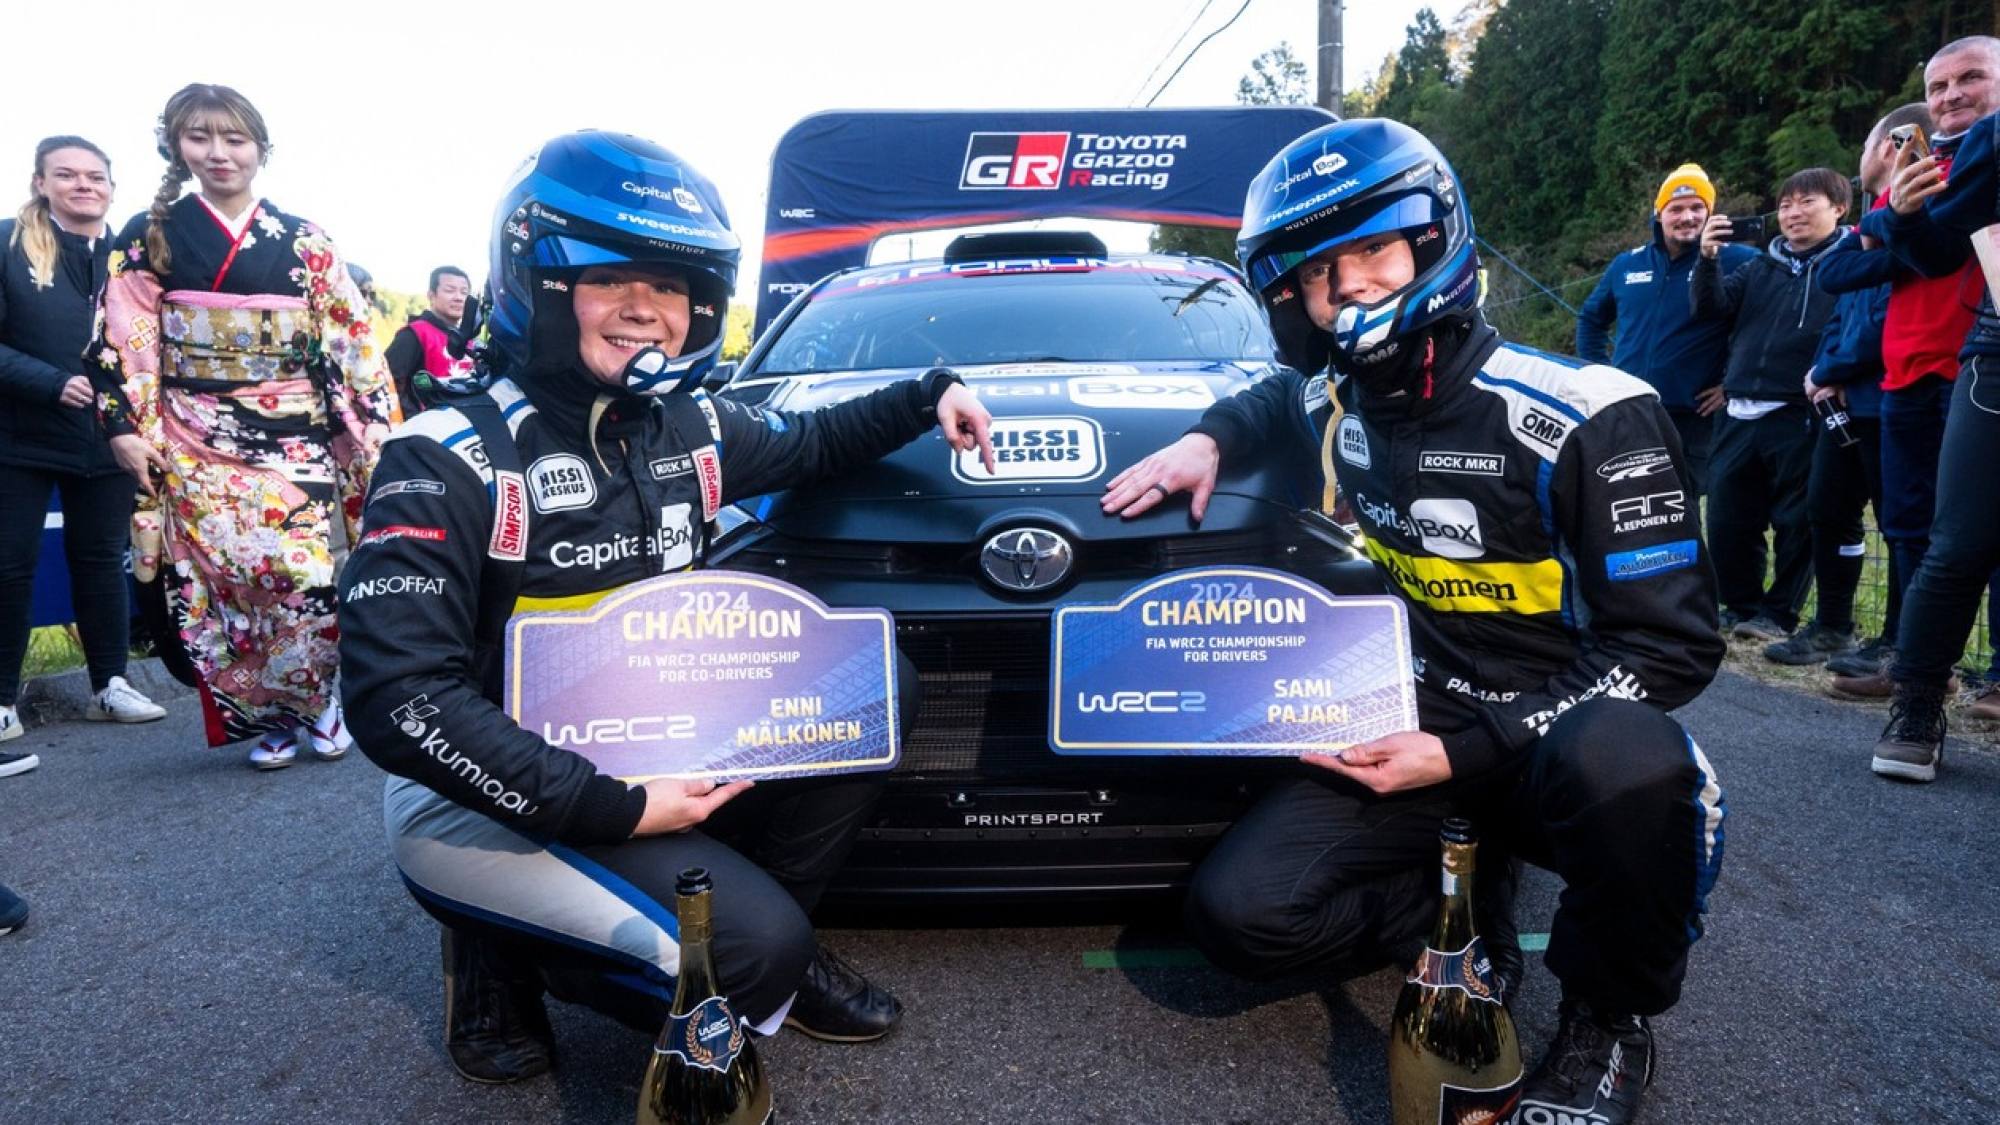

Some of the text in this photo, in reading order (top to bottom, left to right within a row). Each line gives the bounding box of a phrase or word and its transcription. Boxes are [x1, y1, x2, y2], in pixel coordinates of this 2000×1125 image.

[1077, 134, 1188, 151] TOYOTA
[966, 155, 1060, 186] GR
[1072, 153, 1176, 169] GAZOO
[1068, 170, 1170, 191] Racing
[1520, 411, 1564, 444] OMP
[1424, 456, 1498, 472] ROCK MKR
[539, 467, 584, 489] HISSI
[702, 456, 718, 516] SIMPSON
[542, 483, 587, 500] KESKUS
[501, 482, 521, 551] SIMPSON
[680, 591, 752, 616] 2024
[1189, 582, 1256, 604] 2024
[1141, 598, 1306, 626] CHAMPION
[622, 609, 801, 642] CHAMPION
[1145, 634, 1306, 650] FIA WRC2 CHAMPIONSHIP
[628, 649, 801, 668] FIA WRC2 CHAMPIONSHIP
[1184, 649, 1268, 663] FOR DRIVERS
[659, 667, 774, 684] FOR CO-DRIVERS
[1273, 678, 1333, 699] SAMI
[770, 696, 822, 717] ENNI
[1078, 691, 1207, 714] WRC2
[1267, 703, 1351, 726] PAJARI
[544, 713, 697, 747] WRC2
[735, 718, 862, 748] MÄLKÖNEN
[418, 727, 540, 817] kumiapu
[964, 812, 1104, 827] PRINTSPORT
